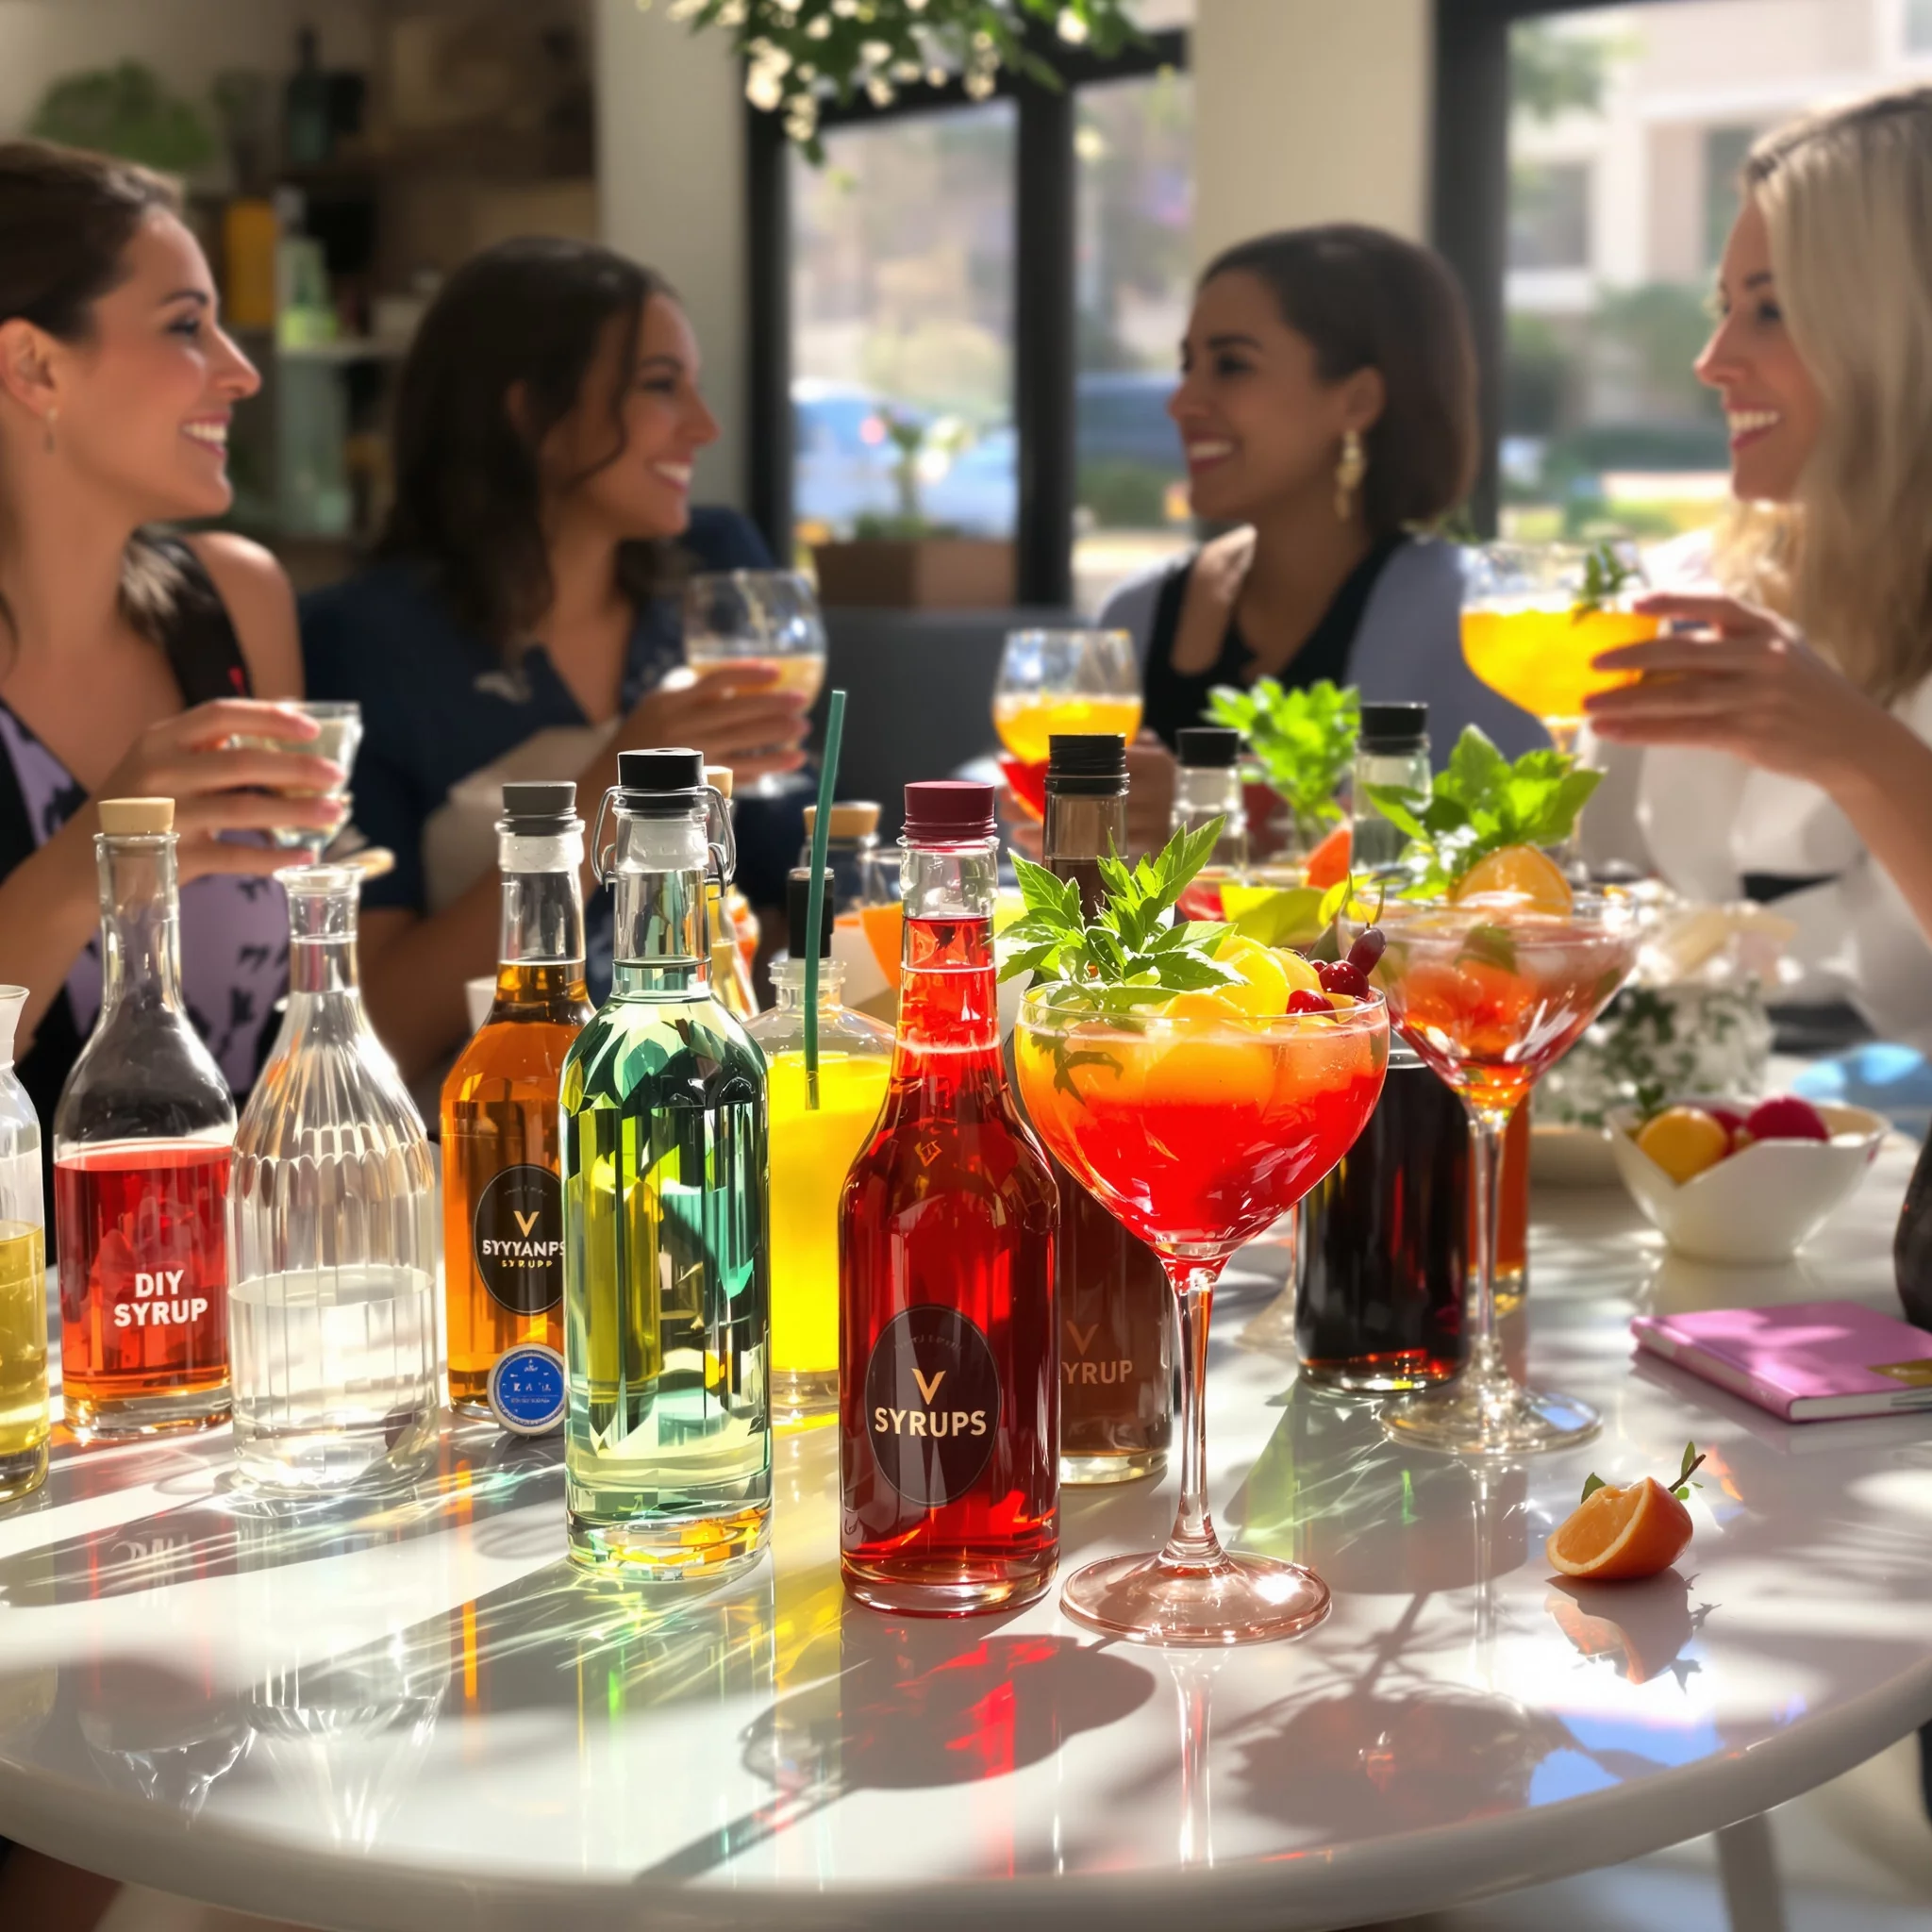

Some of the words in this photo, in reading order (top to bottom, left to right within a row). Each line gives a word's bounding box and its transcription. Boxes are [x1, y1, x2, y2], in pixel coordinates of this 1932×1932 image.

[135, 1269, 184, 1298] DIY
[114, 1297, 208, 1327] SYRUP
[1061, 1360, 1133, 1384] YRUP
[874, 1407, 987, 1438] SYRUPS
